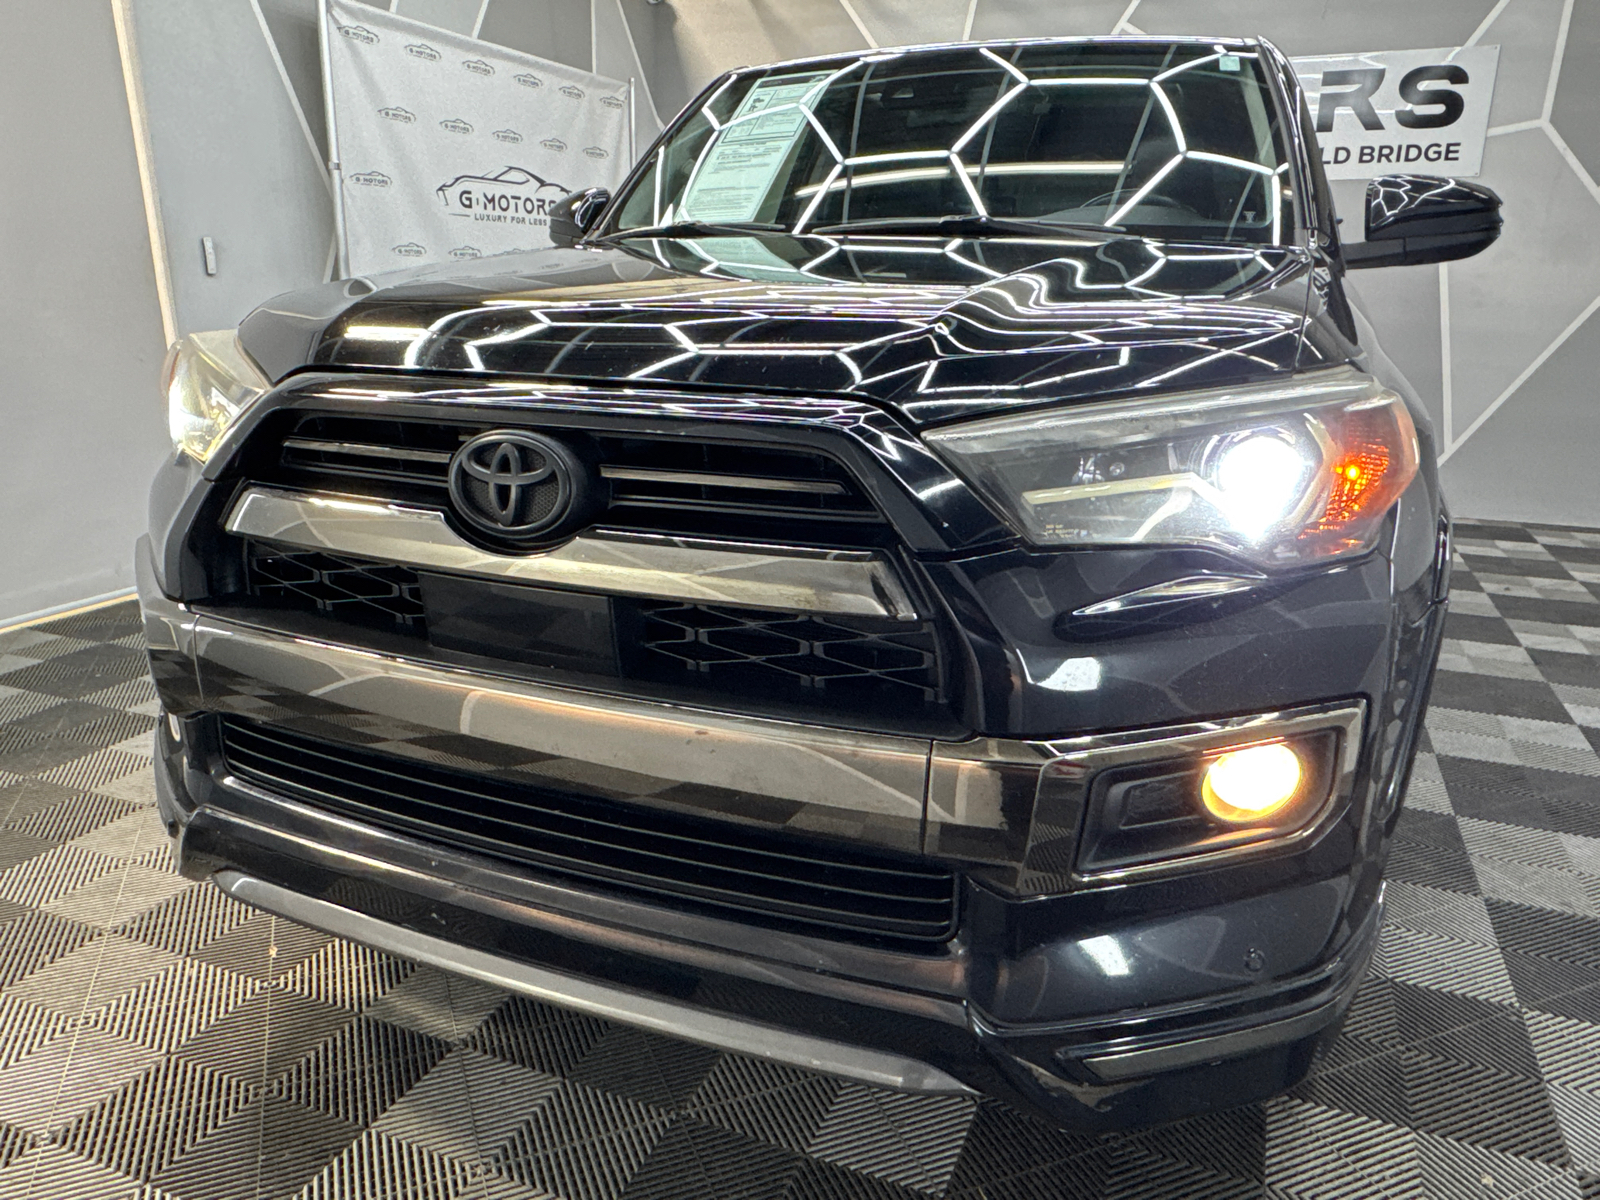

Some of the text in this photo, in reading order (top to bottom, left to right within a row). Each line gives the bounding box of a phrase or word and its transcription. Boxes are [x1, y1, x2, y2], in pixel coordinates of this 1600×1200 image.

[1358, 142, 1461, 164] BRIDGE
[474, 213, 547, 226] LUXURY FOR LESS
